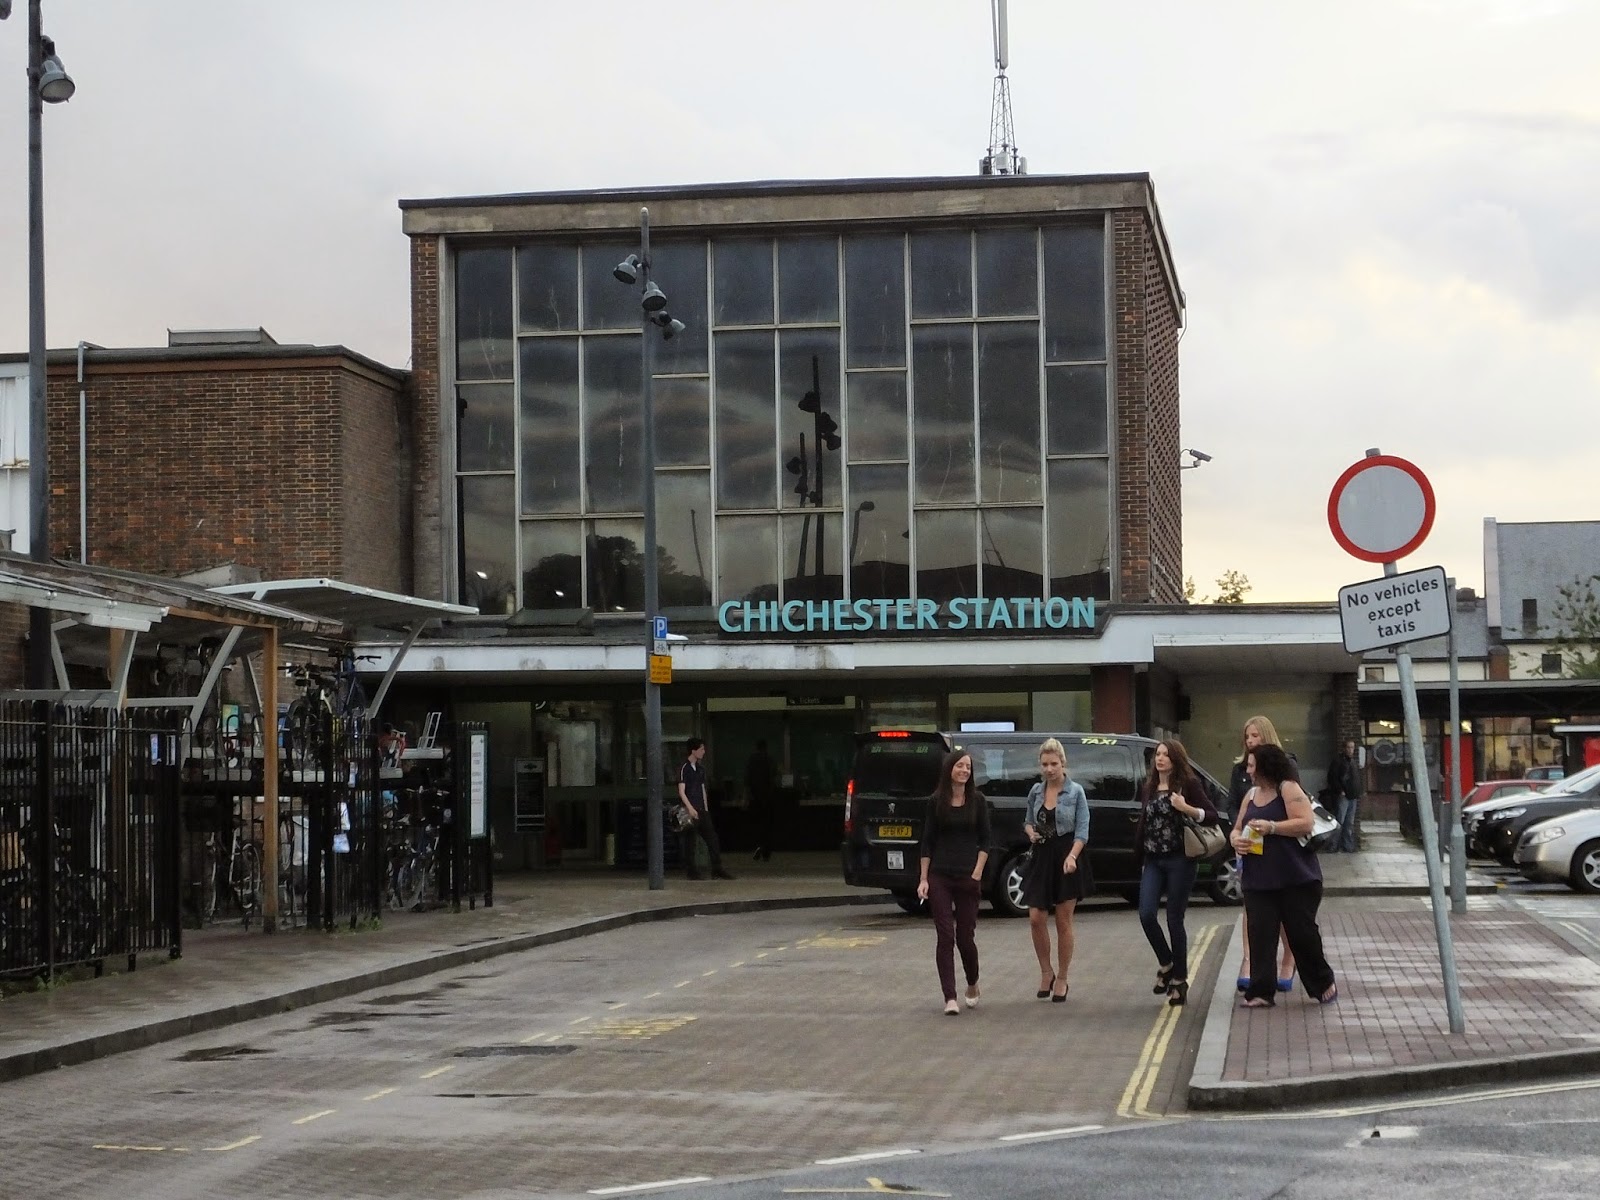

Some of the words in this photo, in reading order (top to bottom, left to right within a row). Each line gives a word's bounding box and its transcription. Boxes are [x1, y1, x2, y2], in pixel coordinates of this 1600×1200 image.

[1347, 593, 1369, 608] No
[1375, 579, 1438, 601] vehicles
[718, 598, 940, 633] CHICHESTER
[948, 596, 1096, 630] STATION
[1368, 599, 1421, 621] except
[656, 619, 666, 638] P
[1377, 620, 1416, 638] taxis
[1081, 738, 1118, 746] TAXI
